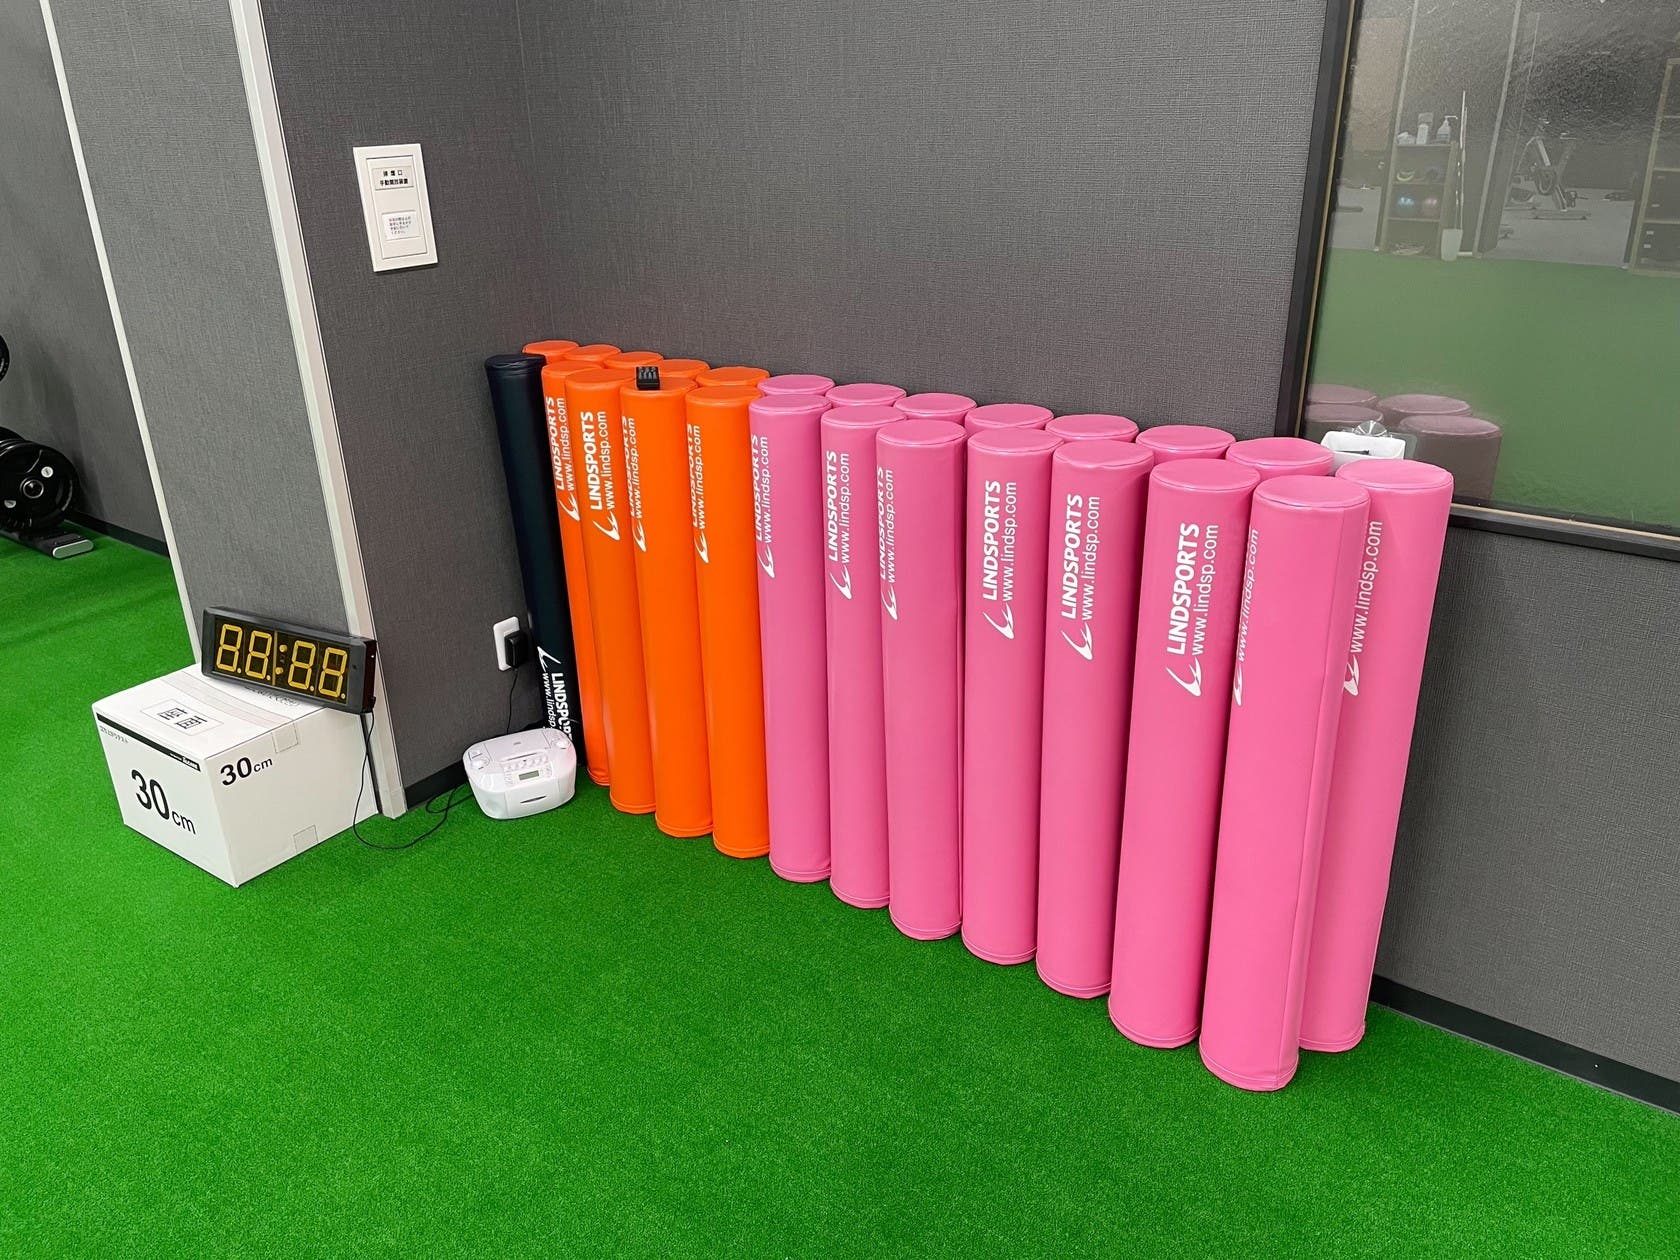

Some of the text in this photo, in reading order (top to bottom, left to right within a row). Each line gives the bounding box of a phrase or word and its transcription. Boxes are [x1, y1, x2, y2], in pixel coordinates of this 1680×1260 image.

[545, 396, 564, 491] LINDSPORTS
[556, 397, 574, 491] www.lindsp.com
[580, 411, 603, 510] LINDSPORTS
[596, 411, 615, 509] www.lindsp.com
[627, 417, 642, 518] www.lindsp.com
[692, 425, 705, 528] www.lindsp.com
[751, 434, 761, 541] LINDSPORTS
[759, 436, 771, 543] www.lindsp.com
[826, 450, 838, 561] LINDSPORTS
[838, 453, 851, 563] www.lindsp.com
[884, 470, 895, 582] www.lindsp.com
[982, 480, 1001, 601] LINDSPORTS
[1000, 482, 1018, 602] www.lindsp.com
[1061, 493, 1083, 619] LINDSPORTS
[1080, 496, 1100, 621] www.lindsp.com
[1166, 522, 1200, 655] LINDSPORTS
[1189, 524, 1219, 656] www.lindsp.com
[1236, 529, 1259, 662] www.lindsp.com
[1349, 521, 1382, 654] www.lindsp.com
